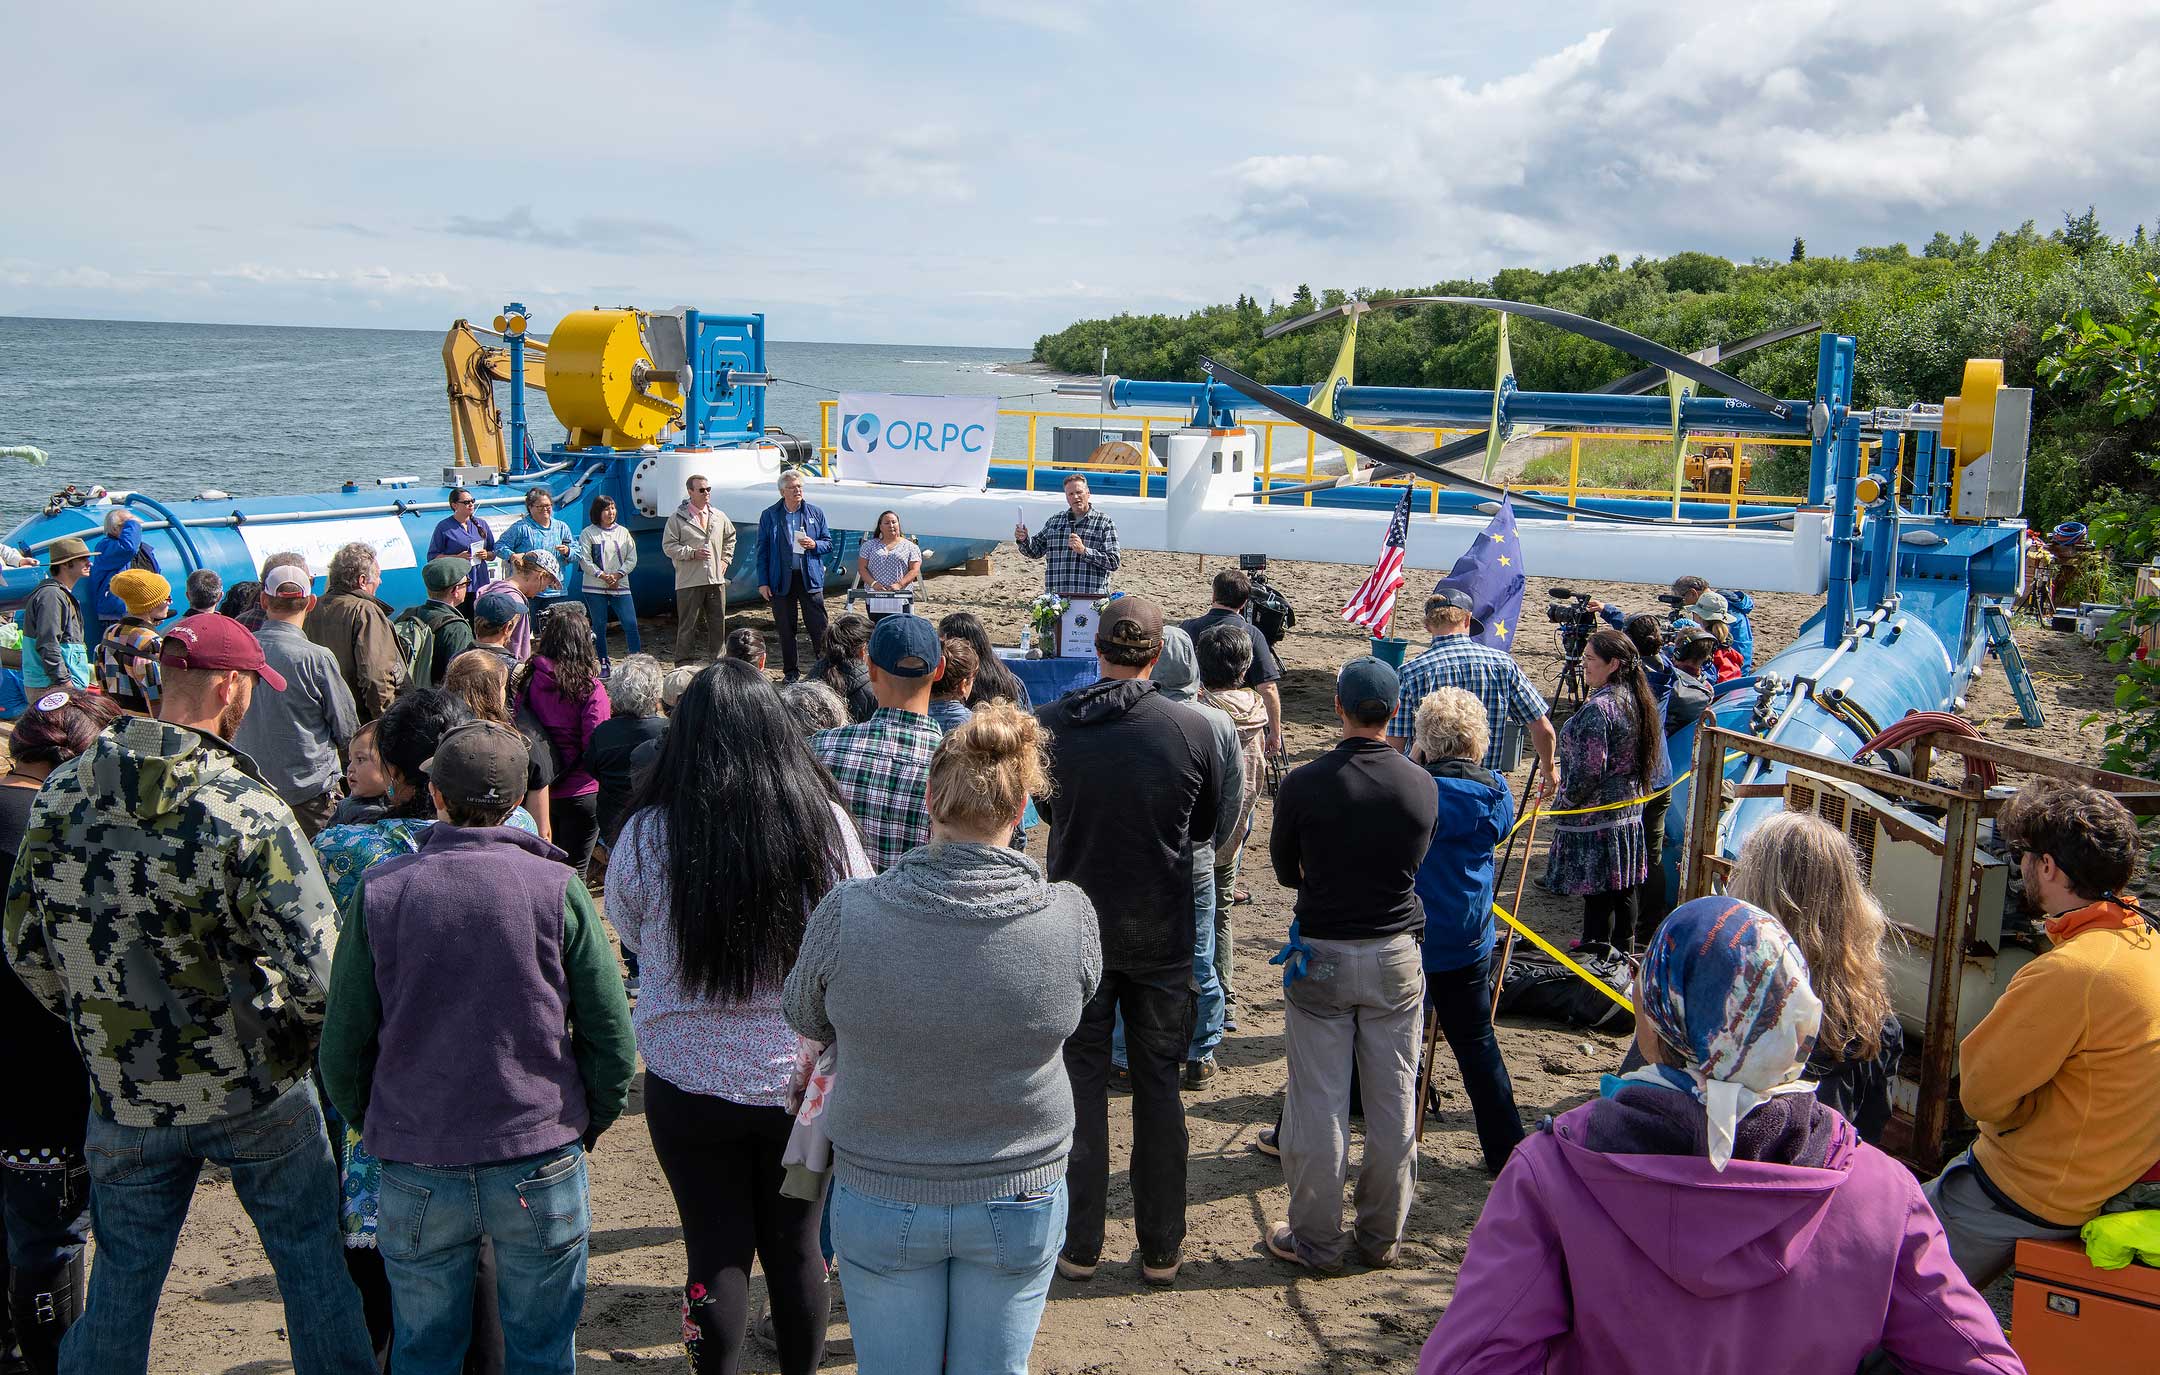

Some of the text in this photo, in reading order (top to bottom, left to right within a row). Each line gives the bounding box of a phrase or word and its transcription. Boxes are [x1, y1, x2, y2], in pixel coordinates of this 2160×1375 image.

[1203, 361, 1214, 371] P2
[1774, 404, 1787, 416] P1
[886, 420, 985, 453] ORPC
